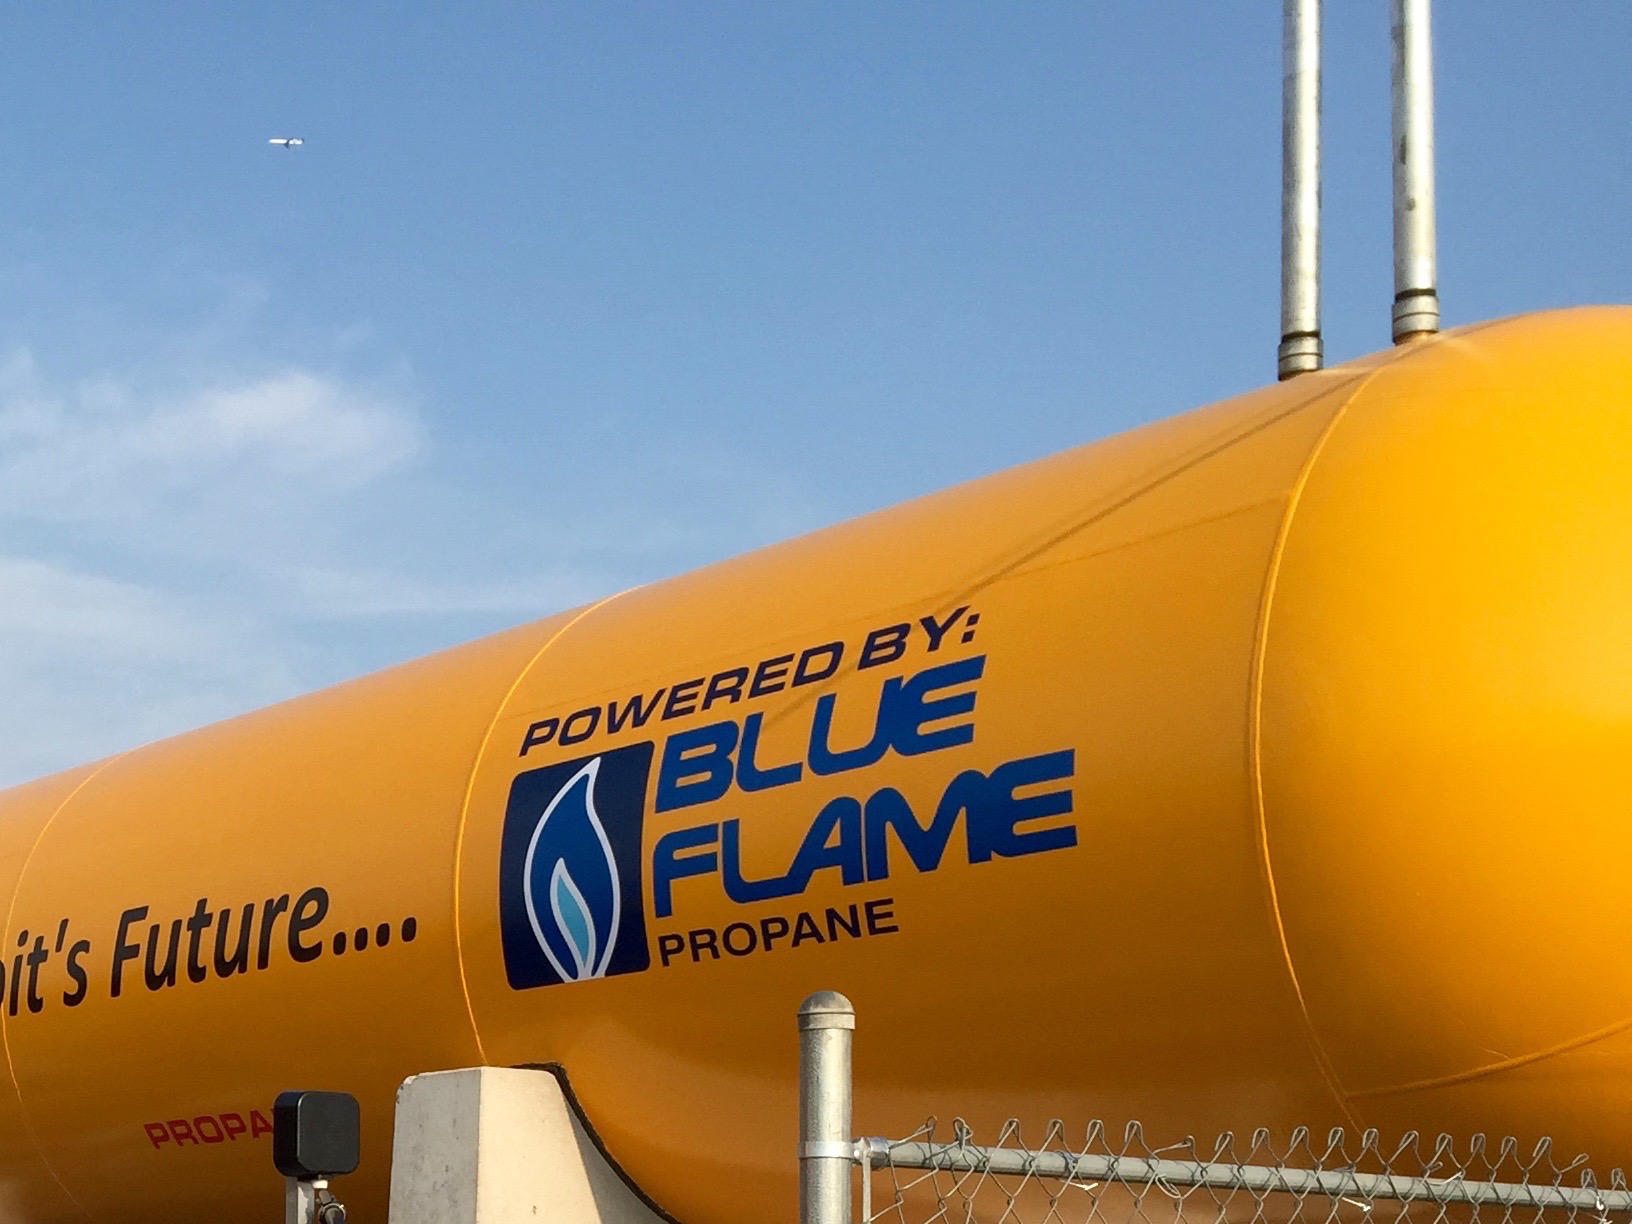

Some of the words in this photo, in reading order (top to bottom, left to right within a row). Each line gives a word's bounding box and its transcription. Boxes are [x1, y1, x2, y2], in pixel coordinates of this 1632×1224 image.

[518, 641, 844, 757] POWERED
[857, 605, 981, 671] BY:
[653, 654, 986, 814] BLUE
[652, 748, 1078, 918] FLAME
[658, 898, 899, 967] PROPANE
[143, 1108, 274, 1150] PROPA
